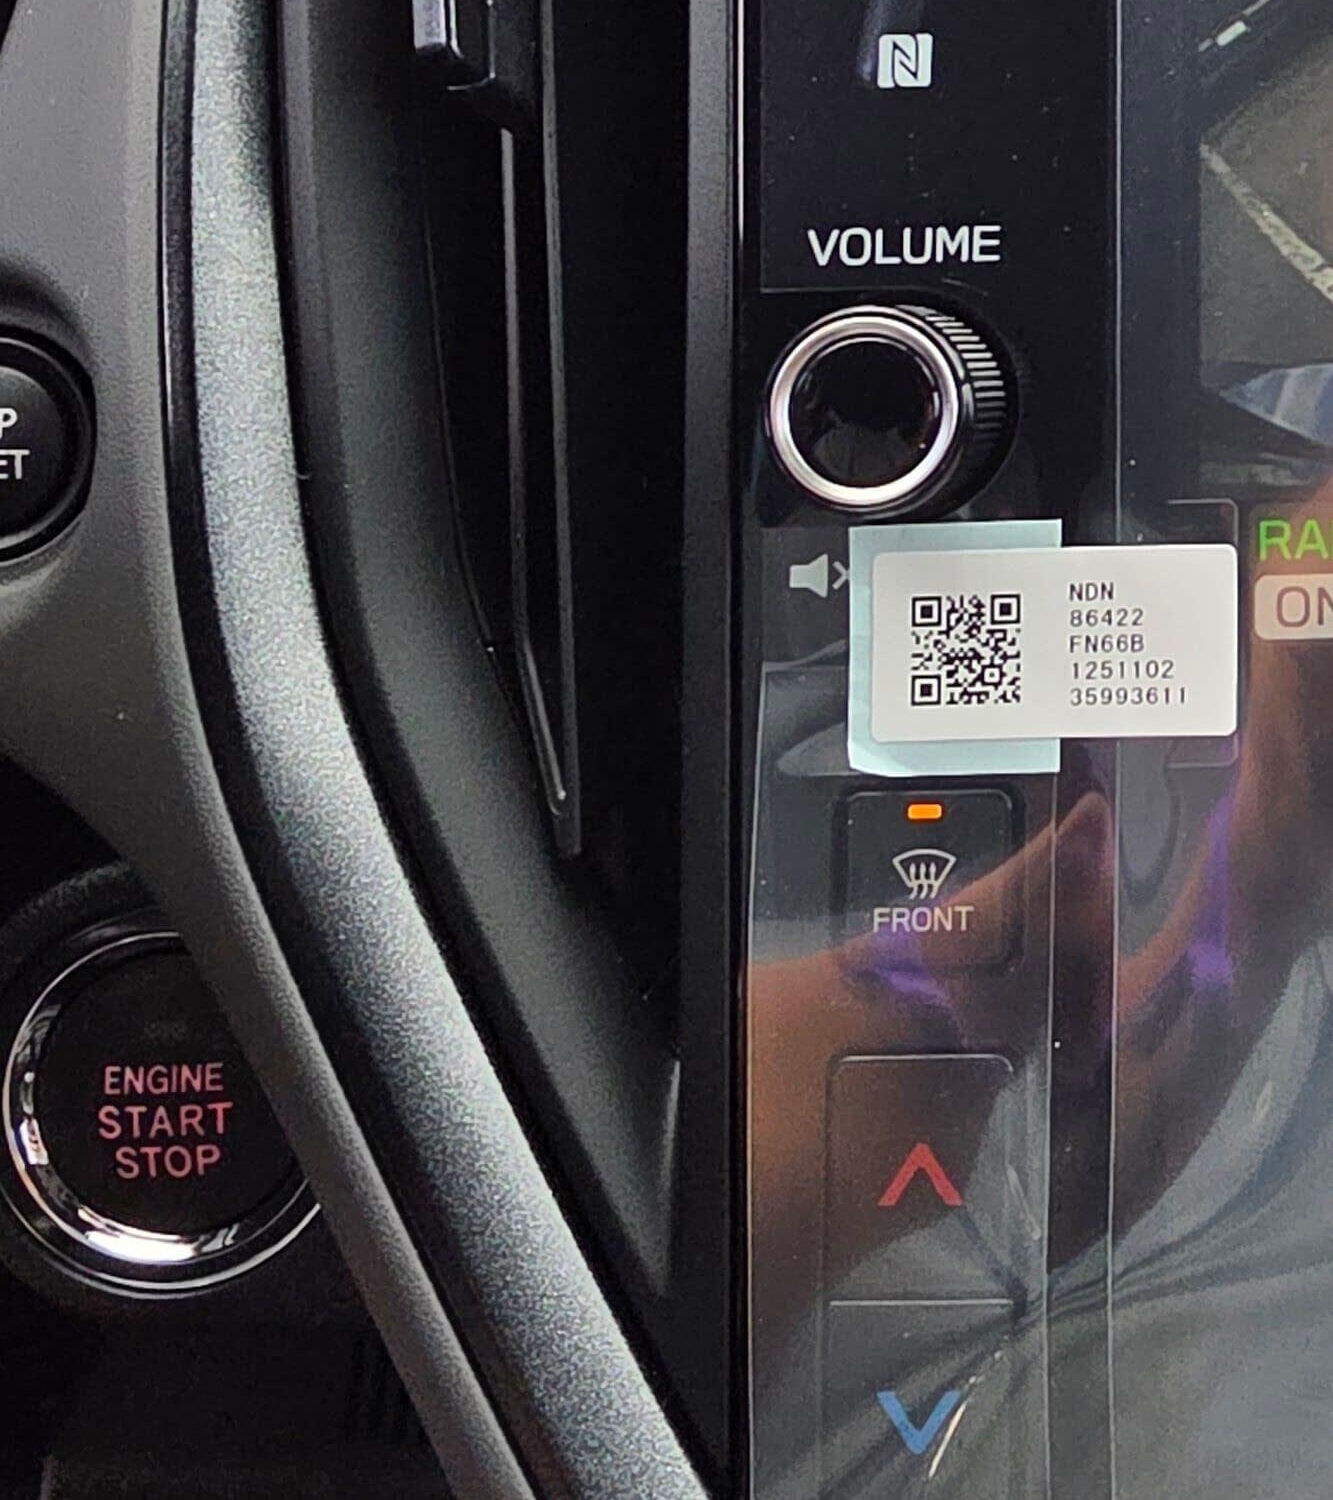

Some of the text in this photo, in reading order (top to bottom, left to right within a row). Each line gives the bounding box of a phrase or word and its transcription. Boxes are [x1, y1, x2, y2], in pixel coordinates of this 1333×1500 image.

[807, 225, 1002, 267] VOLUME
[1068, 581, 1115, 602] NDN
[1069, 607, 1145, 628] 86422
[1068, 633, 1145, 654] FN66B
[1072, 659, 1175, 681] 1251102
[1069, 686, 1186, 707] 35993611
[873, 905, 976, 933] FRONT
[103, 1062, 224, 1096] ENGINE
[98, 1101, 234, 1140] START
[115, 1144, 222, 1180] STOP
